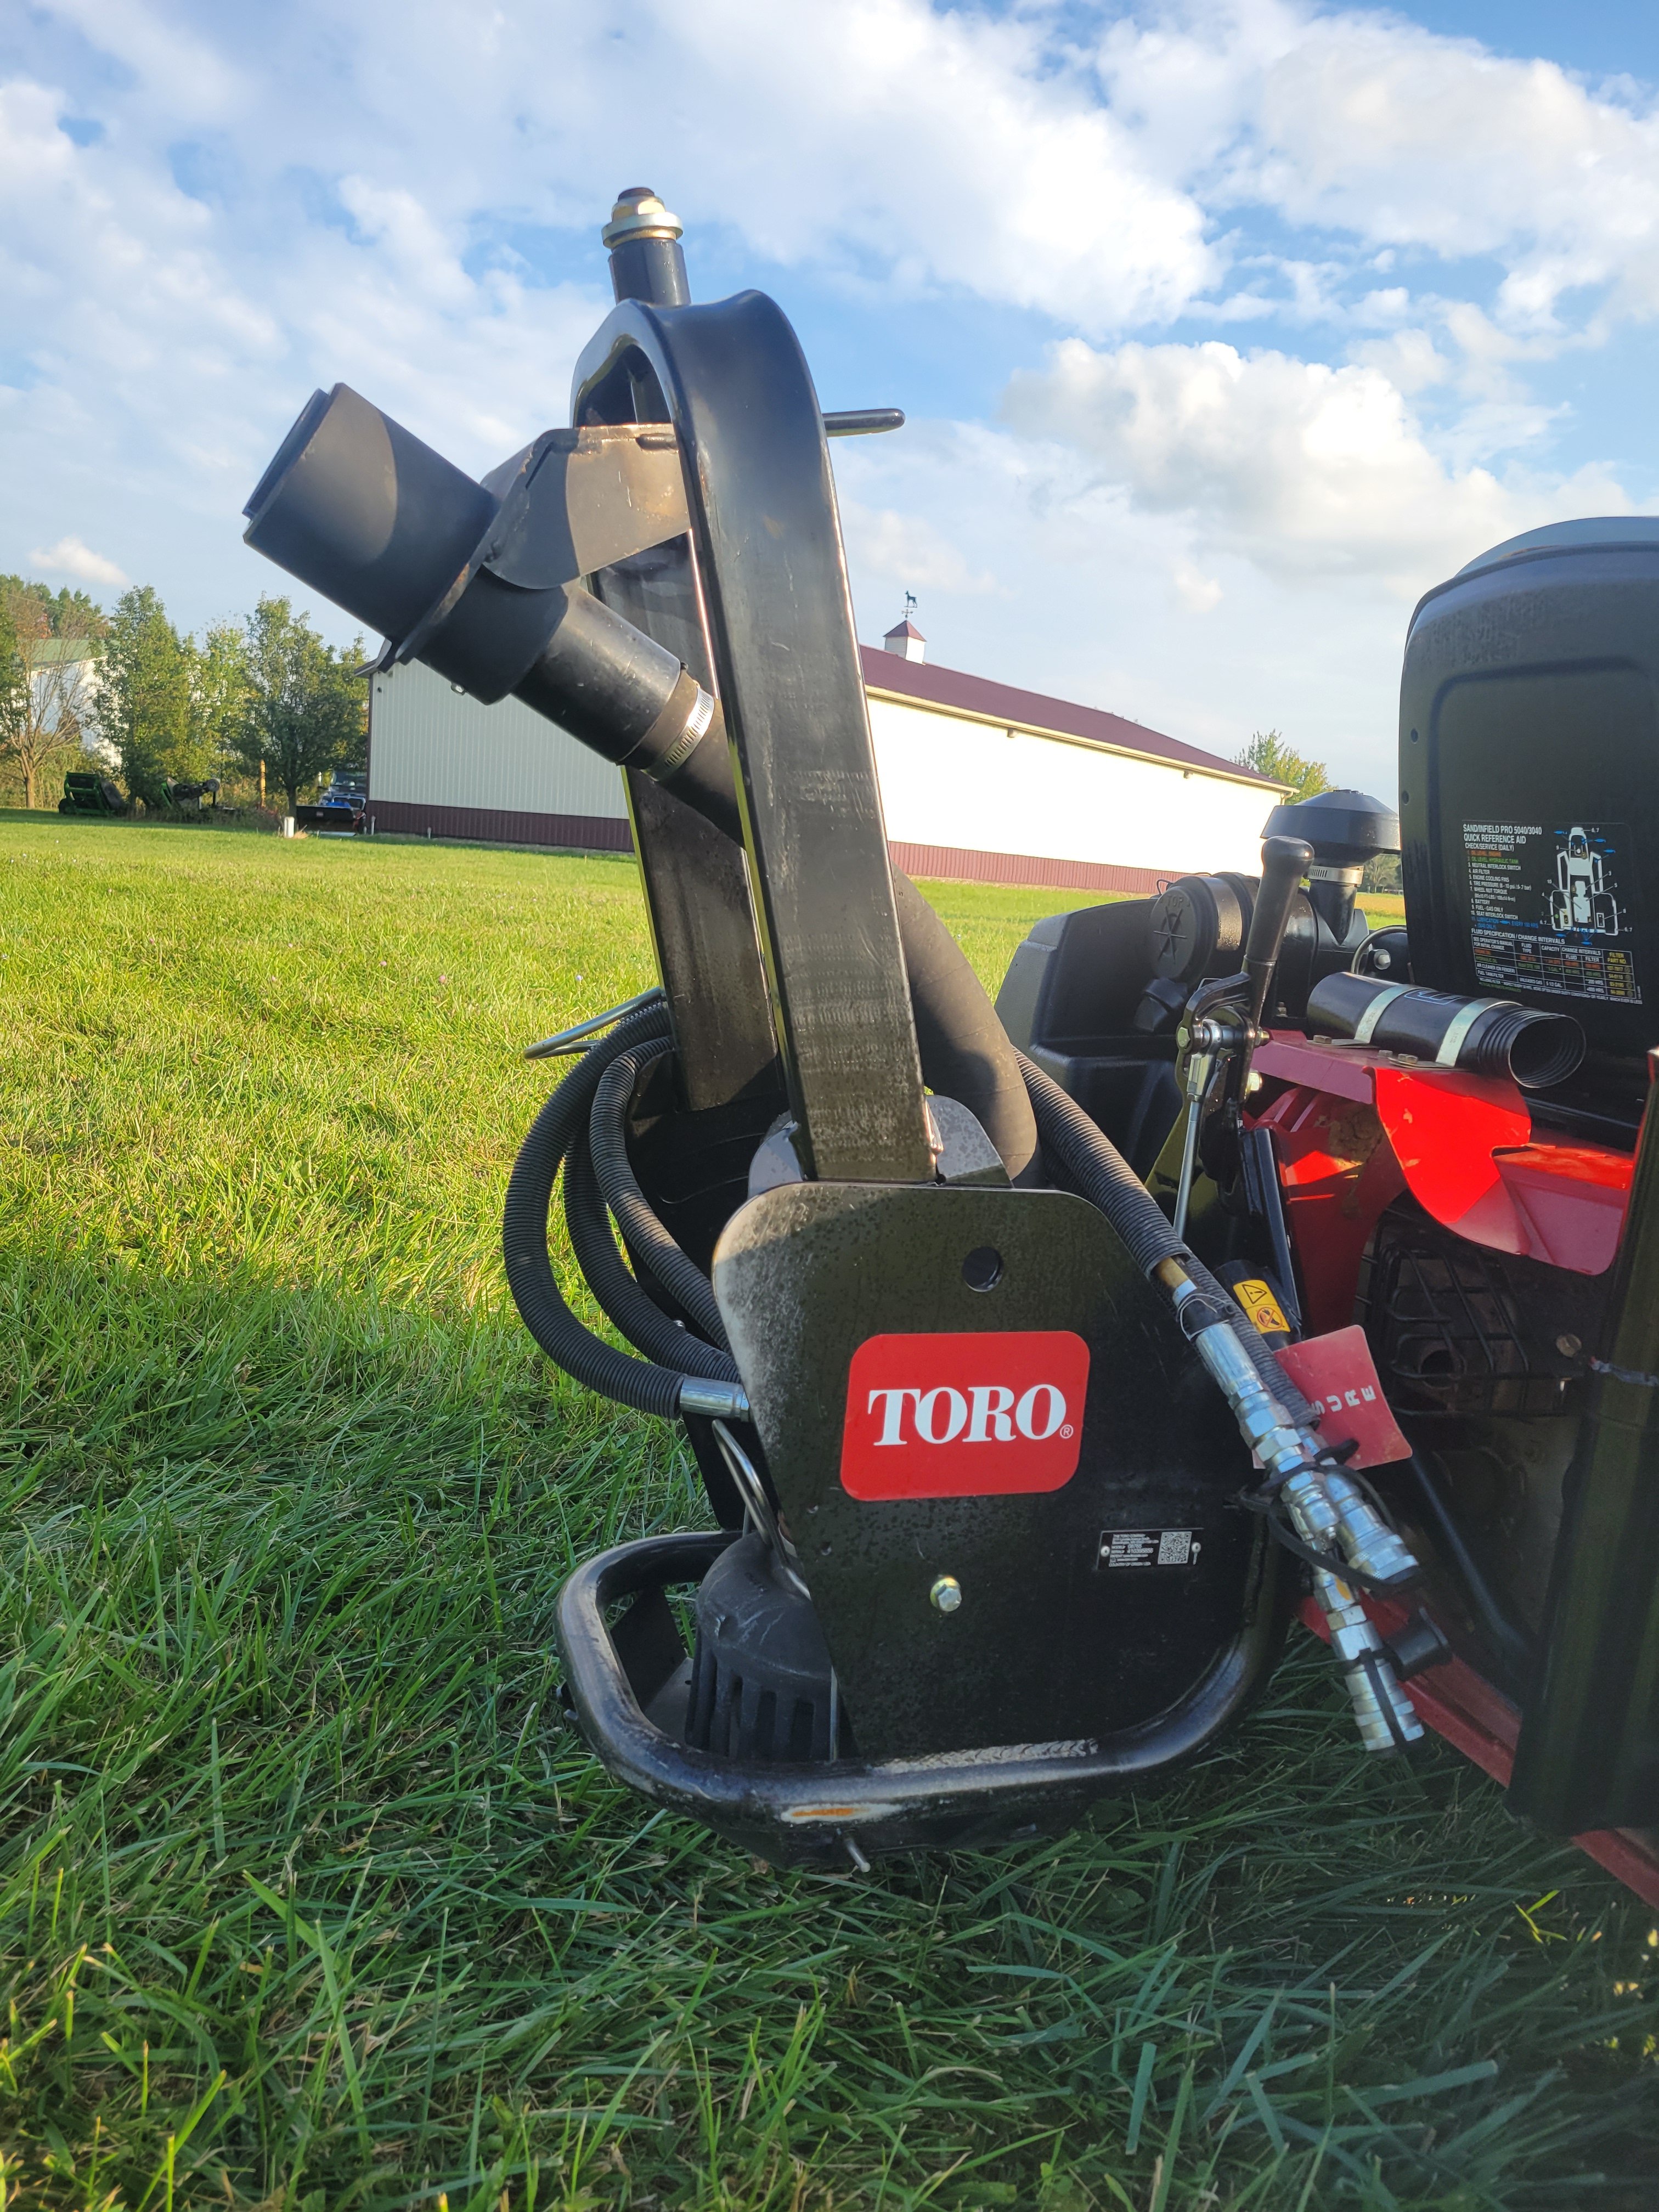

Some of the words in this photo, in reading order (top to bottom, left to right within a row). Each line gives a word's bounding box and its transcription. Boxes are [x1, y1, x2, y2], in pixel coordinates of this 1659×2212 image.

[1463, 824, 1500, 833] SAND/INFIELD
[1500, 825, 1513, 834] PRO
[1514, 826, 1543, 835] 5040/3040
[1464, 833, 1481, 842] QUICK
[1481, 834, 1515, 844] REFERENCE
[1516, 835, 1526, 844] AID
[1465, 842, 1498, 850] CHECK/SERVICE
[1498, 844, 1514, 852] (DAILY)
[1483, 929, 1515, 939] SPECIFICATION
[1538, 936, 1565, 945] INTERVALS
